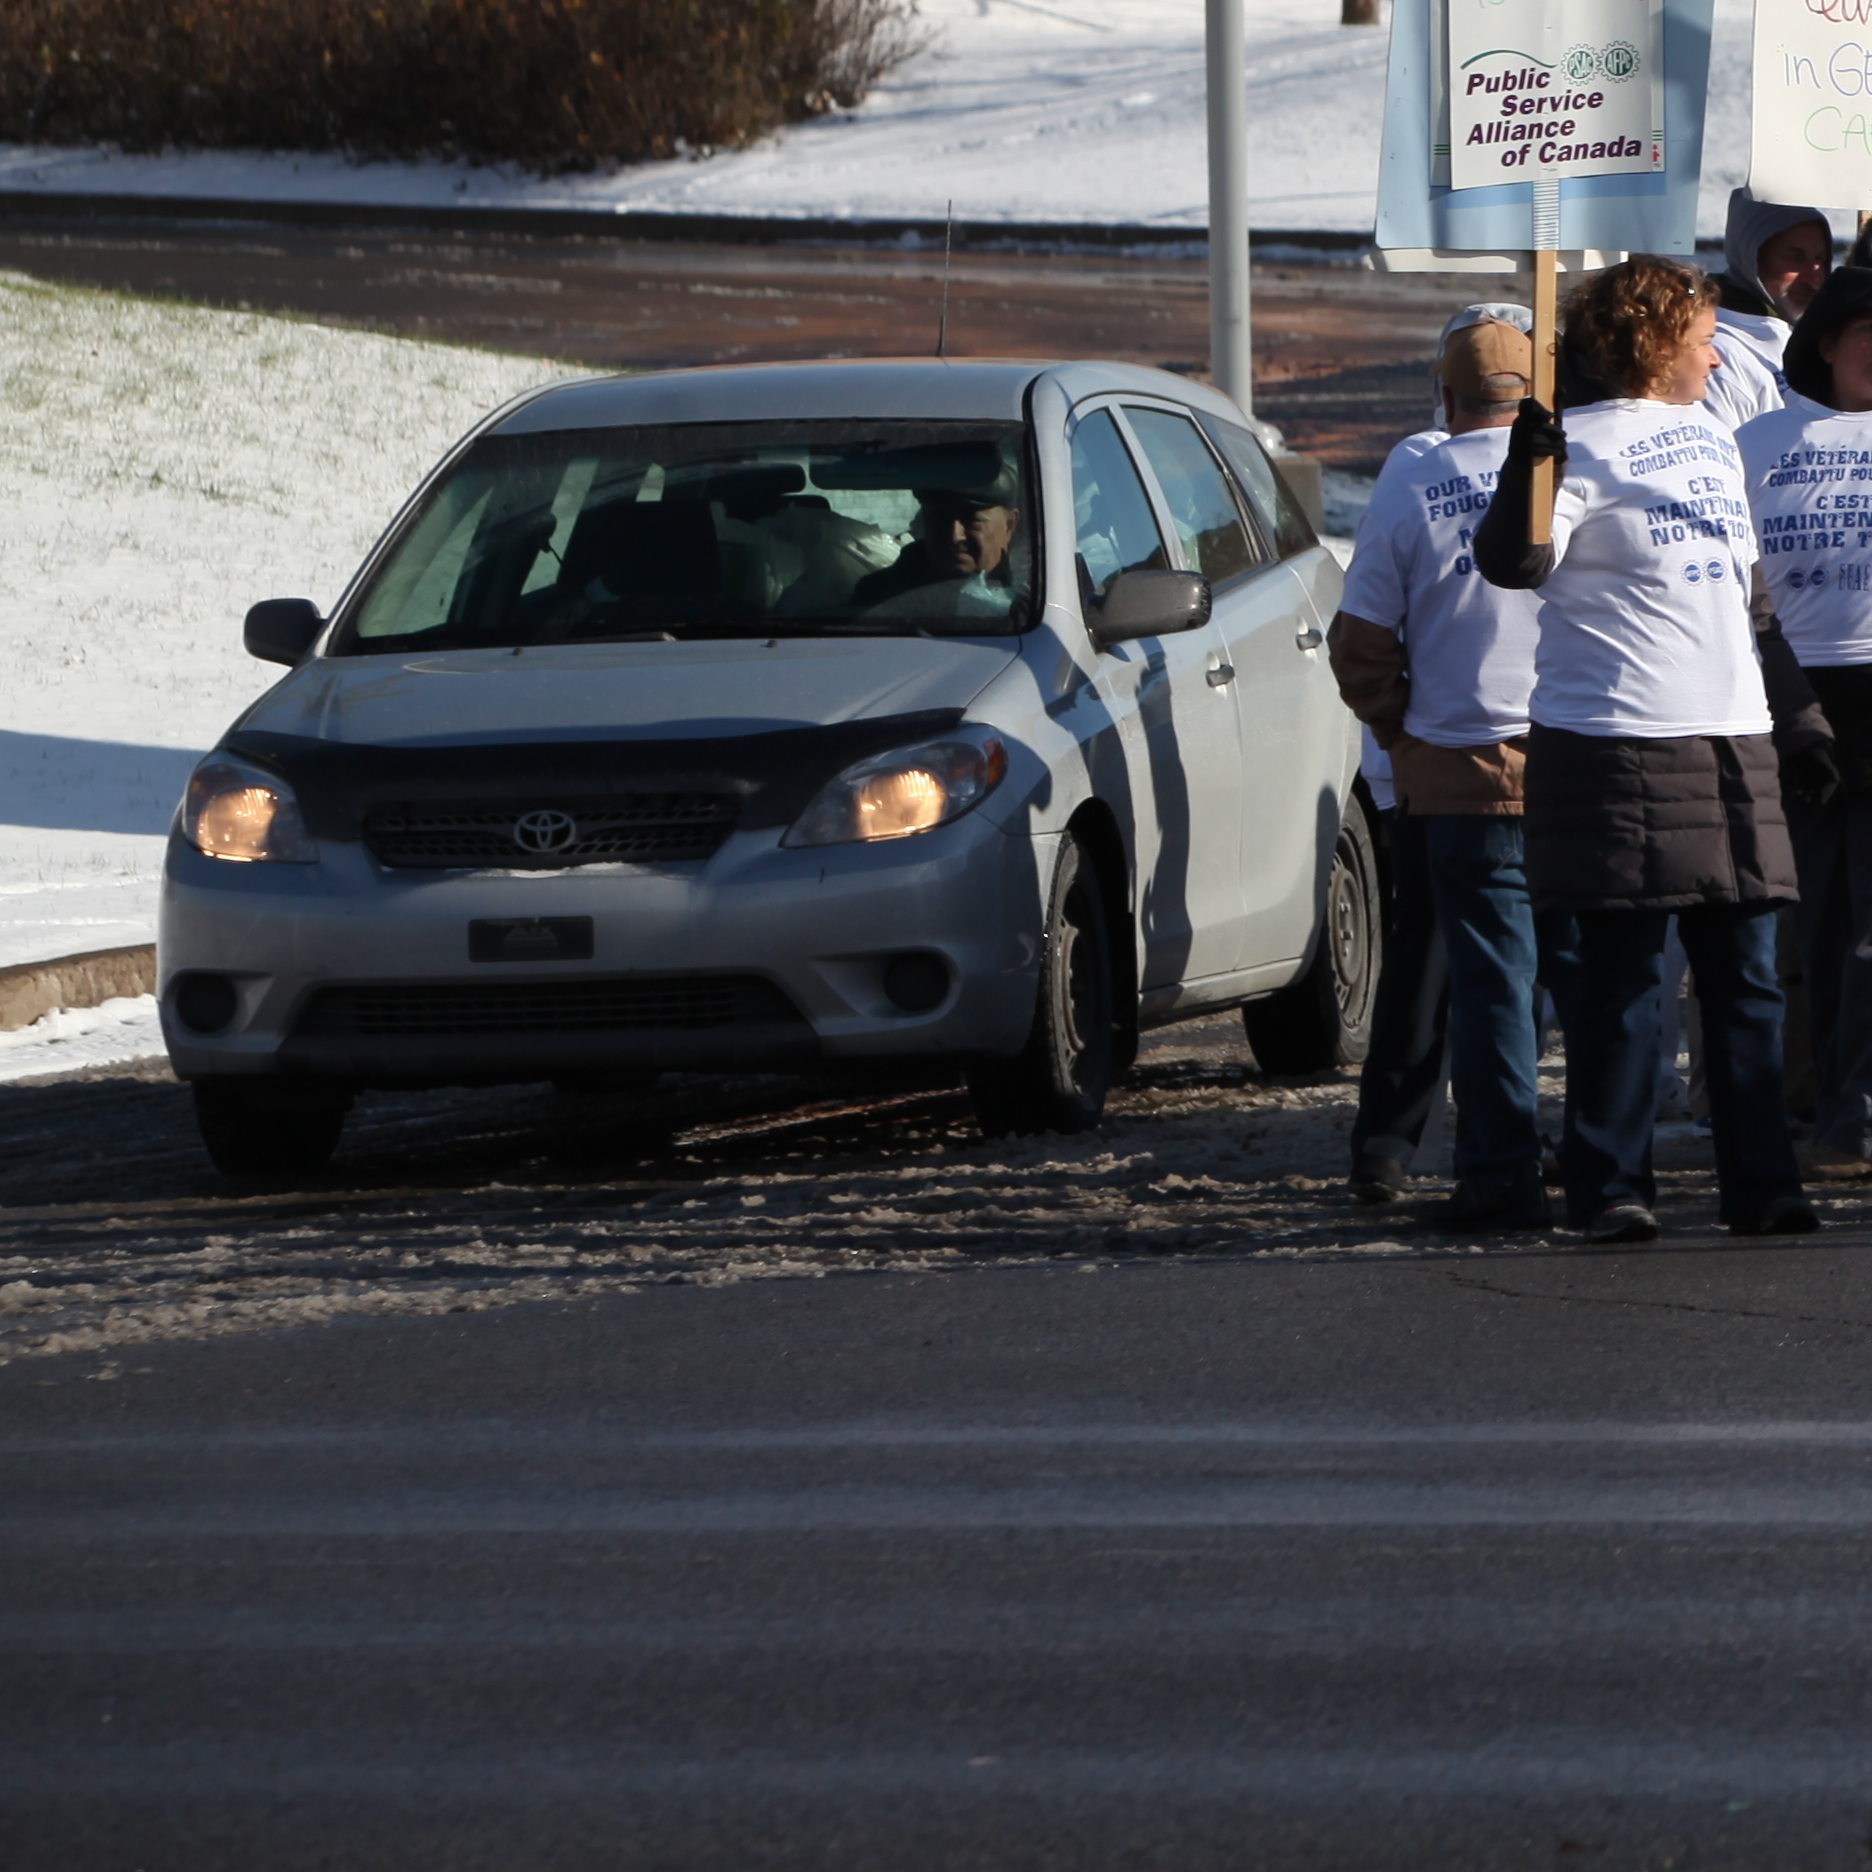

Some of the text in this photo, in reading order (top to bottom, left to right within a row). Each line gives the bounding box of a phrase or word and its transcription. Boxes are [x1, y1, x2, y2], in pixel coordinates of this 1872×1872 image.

[1465, 68, 1551, 96] Public
[1500, 91, 1604, 117] Service
[1465, 119, 1576, 146] Alliance
[1501, 137, 1642, 167] of Canada
[1629, 446, 1698, 477] COMBATTU
[1425, 476, 1471, 501] OUR
[1768, 467, 1845, 486] COMBATTU
[1817, 494, 1872, 509] C'EST
[1650, 517, 1728, 546] NOTRE
[1763, 531, 1845, 555] NOTRE
